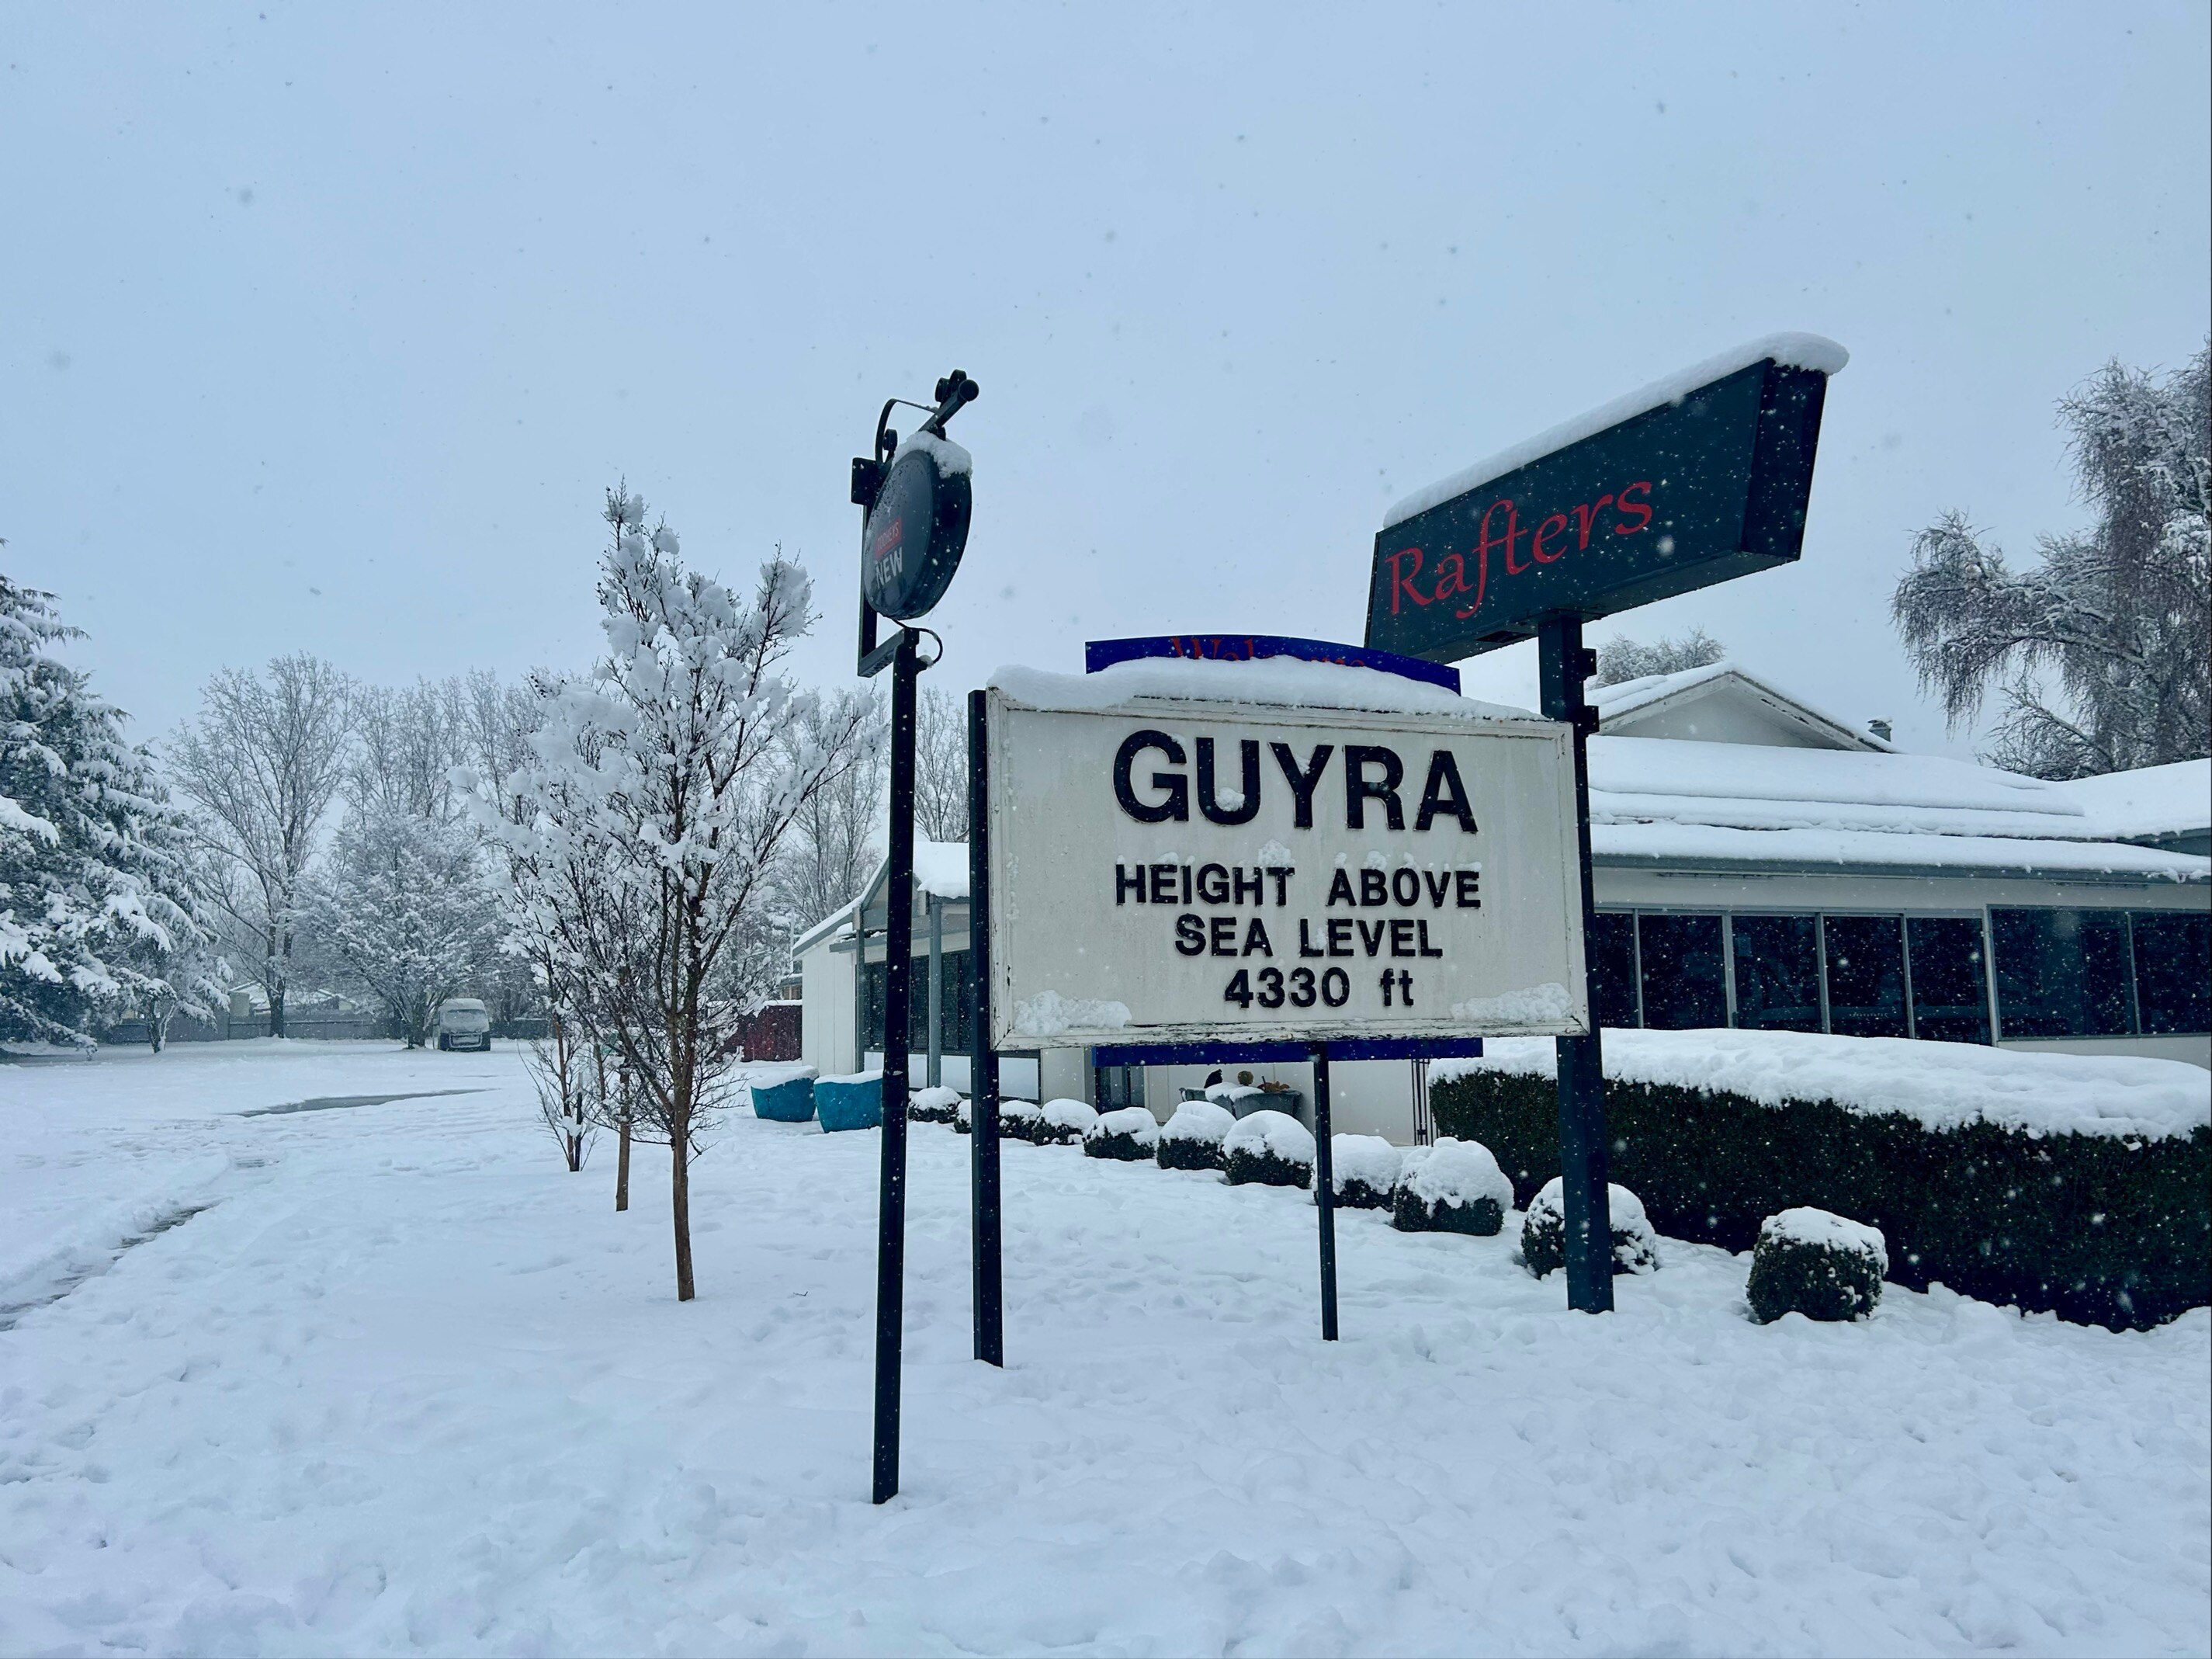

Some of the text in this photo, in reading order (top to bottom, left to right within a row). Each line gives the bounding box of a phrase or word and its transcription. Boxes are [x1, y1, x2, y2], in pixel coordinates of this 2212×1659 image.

[875, 546, 903, 590] NEW
[1385, 481, 1654, 619] Rafters
[1112, 729, 1479, 834] GUYRA
[1115, 862, 1482, 909] HEIGHT ABOVE
[1174, 913, 1444, 959] SEA LEVEL
[1223, 967, 1414, 1008] 4330 ft
